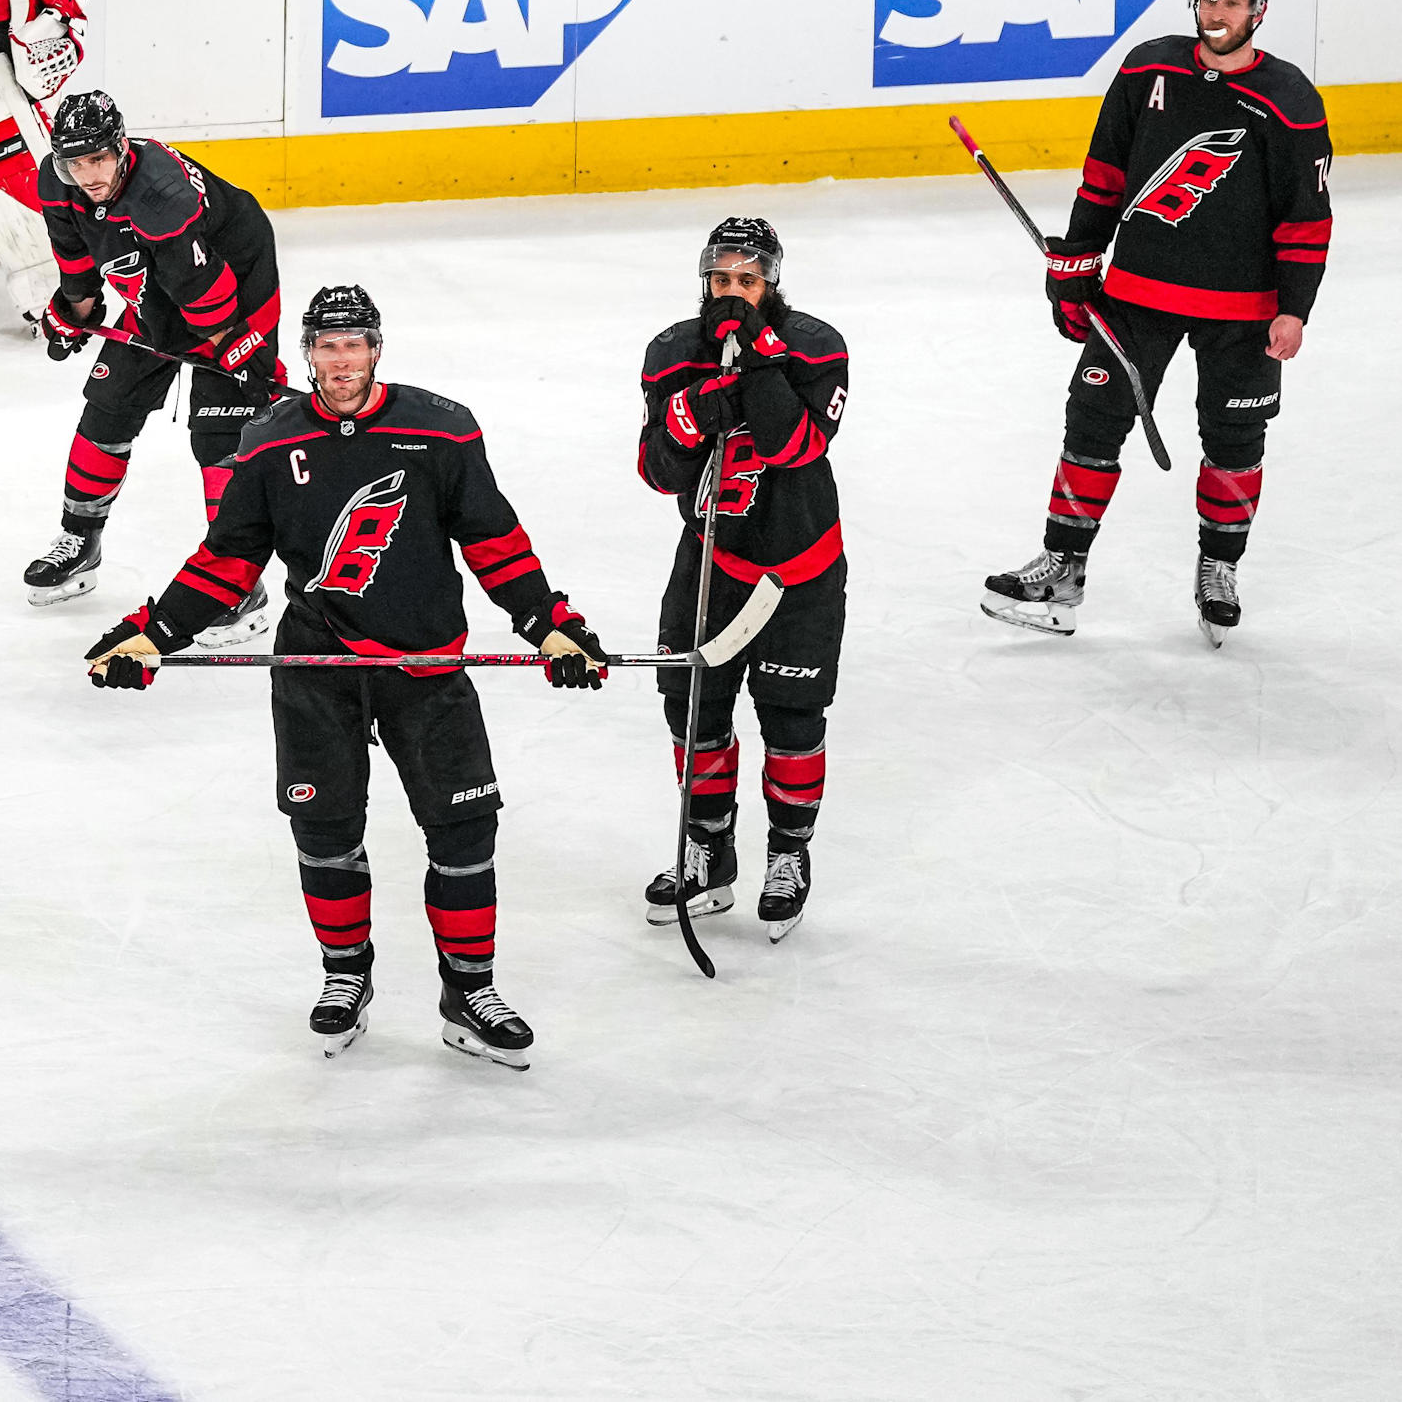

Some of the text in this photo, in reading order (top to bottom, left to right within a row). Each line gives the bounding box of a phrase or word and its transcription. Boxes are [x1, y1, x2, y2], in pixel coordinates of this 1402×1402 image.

[1147, 74, 1166, 110] A
[1236, 99, 1268, 120] NUCOR
[62, 139, 86, 149] BAUER
[722, 231, 748, 240] BAUER
[190, 239, 208, 268] 4
[322, 310, 350, 319] BAUER
[225, 330, 265, 367] BAU
[1225, 390, 1279, 410] BAUER
[196, 405, 256, 418] BAUER
[391, 442, 428, 452] NUCOR
[289, 448, 311, 486] C
[759, 660, 823, 679] CCM
